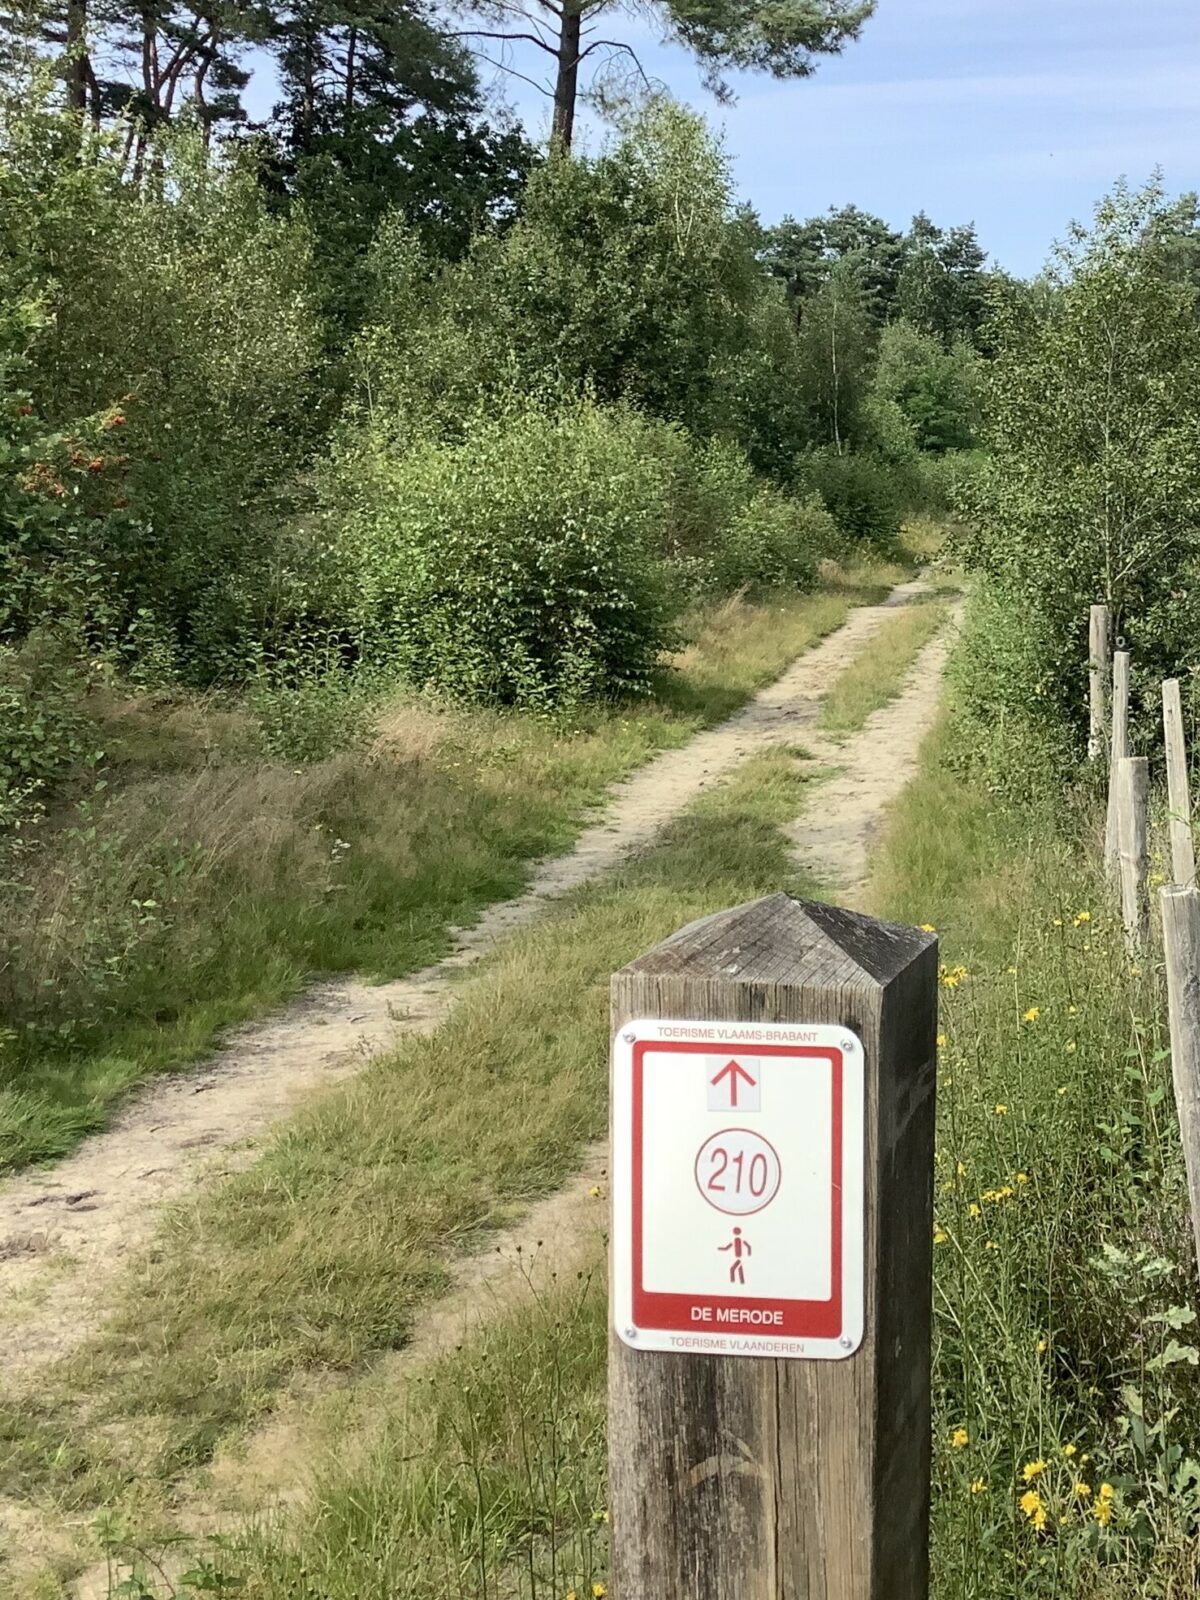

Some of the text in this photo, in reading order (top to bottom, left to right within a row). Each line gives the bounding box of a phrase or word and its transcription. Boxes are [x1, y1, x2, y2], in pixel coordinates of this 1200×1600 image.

[658, 1026, 818, 1042] TOERISME VLAAMS-BRABANT
[708, 1148, 768, 1197] 210
[691, 1306, 784, 1325] DE MERODE
[670, 1336, 805, 1353] TOERISME VLAANDEREN
